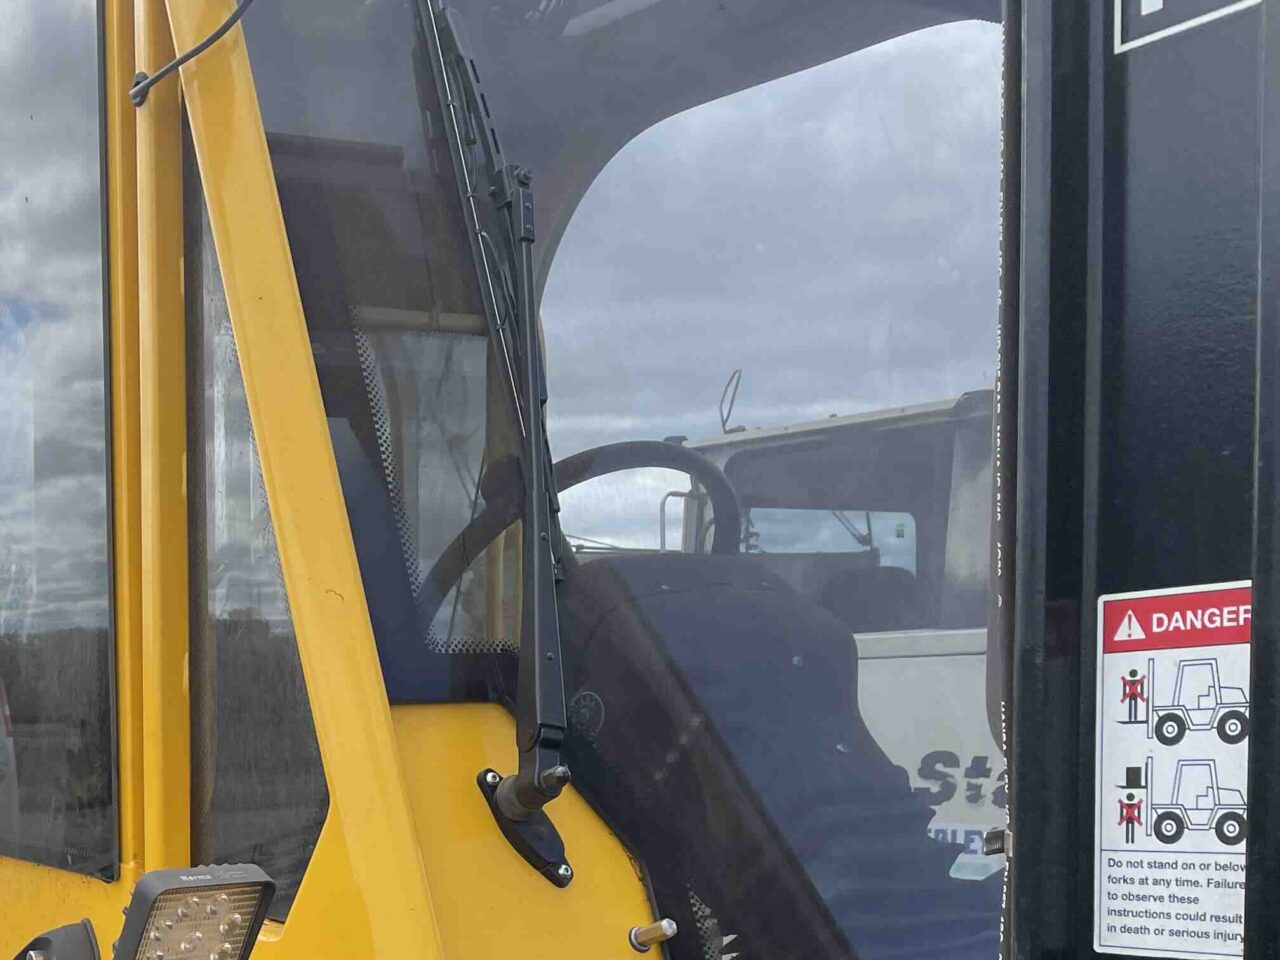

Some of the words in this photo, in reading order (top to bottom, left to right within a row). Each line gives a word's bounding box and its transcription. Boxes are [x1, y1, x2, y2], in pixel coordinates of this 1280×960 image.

[1107, 857, 1123, 869] Do
[1125, 859, 1144, 869] not
[1147, 859, 1178, 870] stand
[1181, 862, 1196, 871] on
[1199, 863, 1211, 871] or
[1107, 875, 1136, 885] forks
[1138, 876, 1149, 886] at
[1152, 878, 1171, 889] any
[1175, 877, 1204, 888] time.
[1206, 878, 1246, 890] Failure
[1107, 891, 1119, 901] to
[1121, 891, 1165, 903] observe
[1168, 893, 1200, 905] these
[1107, 907, 1171, 920] instructions
[1175, 911, 1207, 922] could
[1210, 913, 1243, 924] result
[1107, 923, 1117, 933] in
[1120, 924, 1150, 935] death
[1153, 928, 1165, 936] or
[1168, 928, 1210, 939] serious
